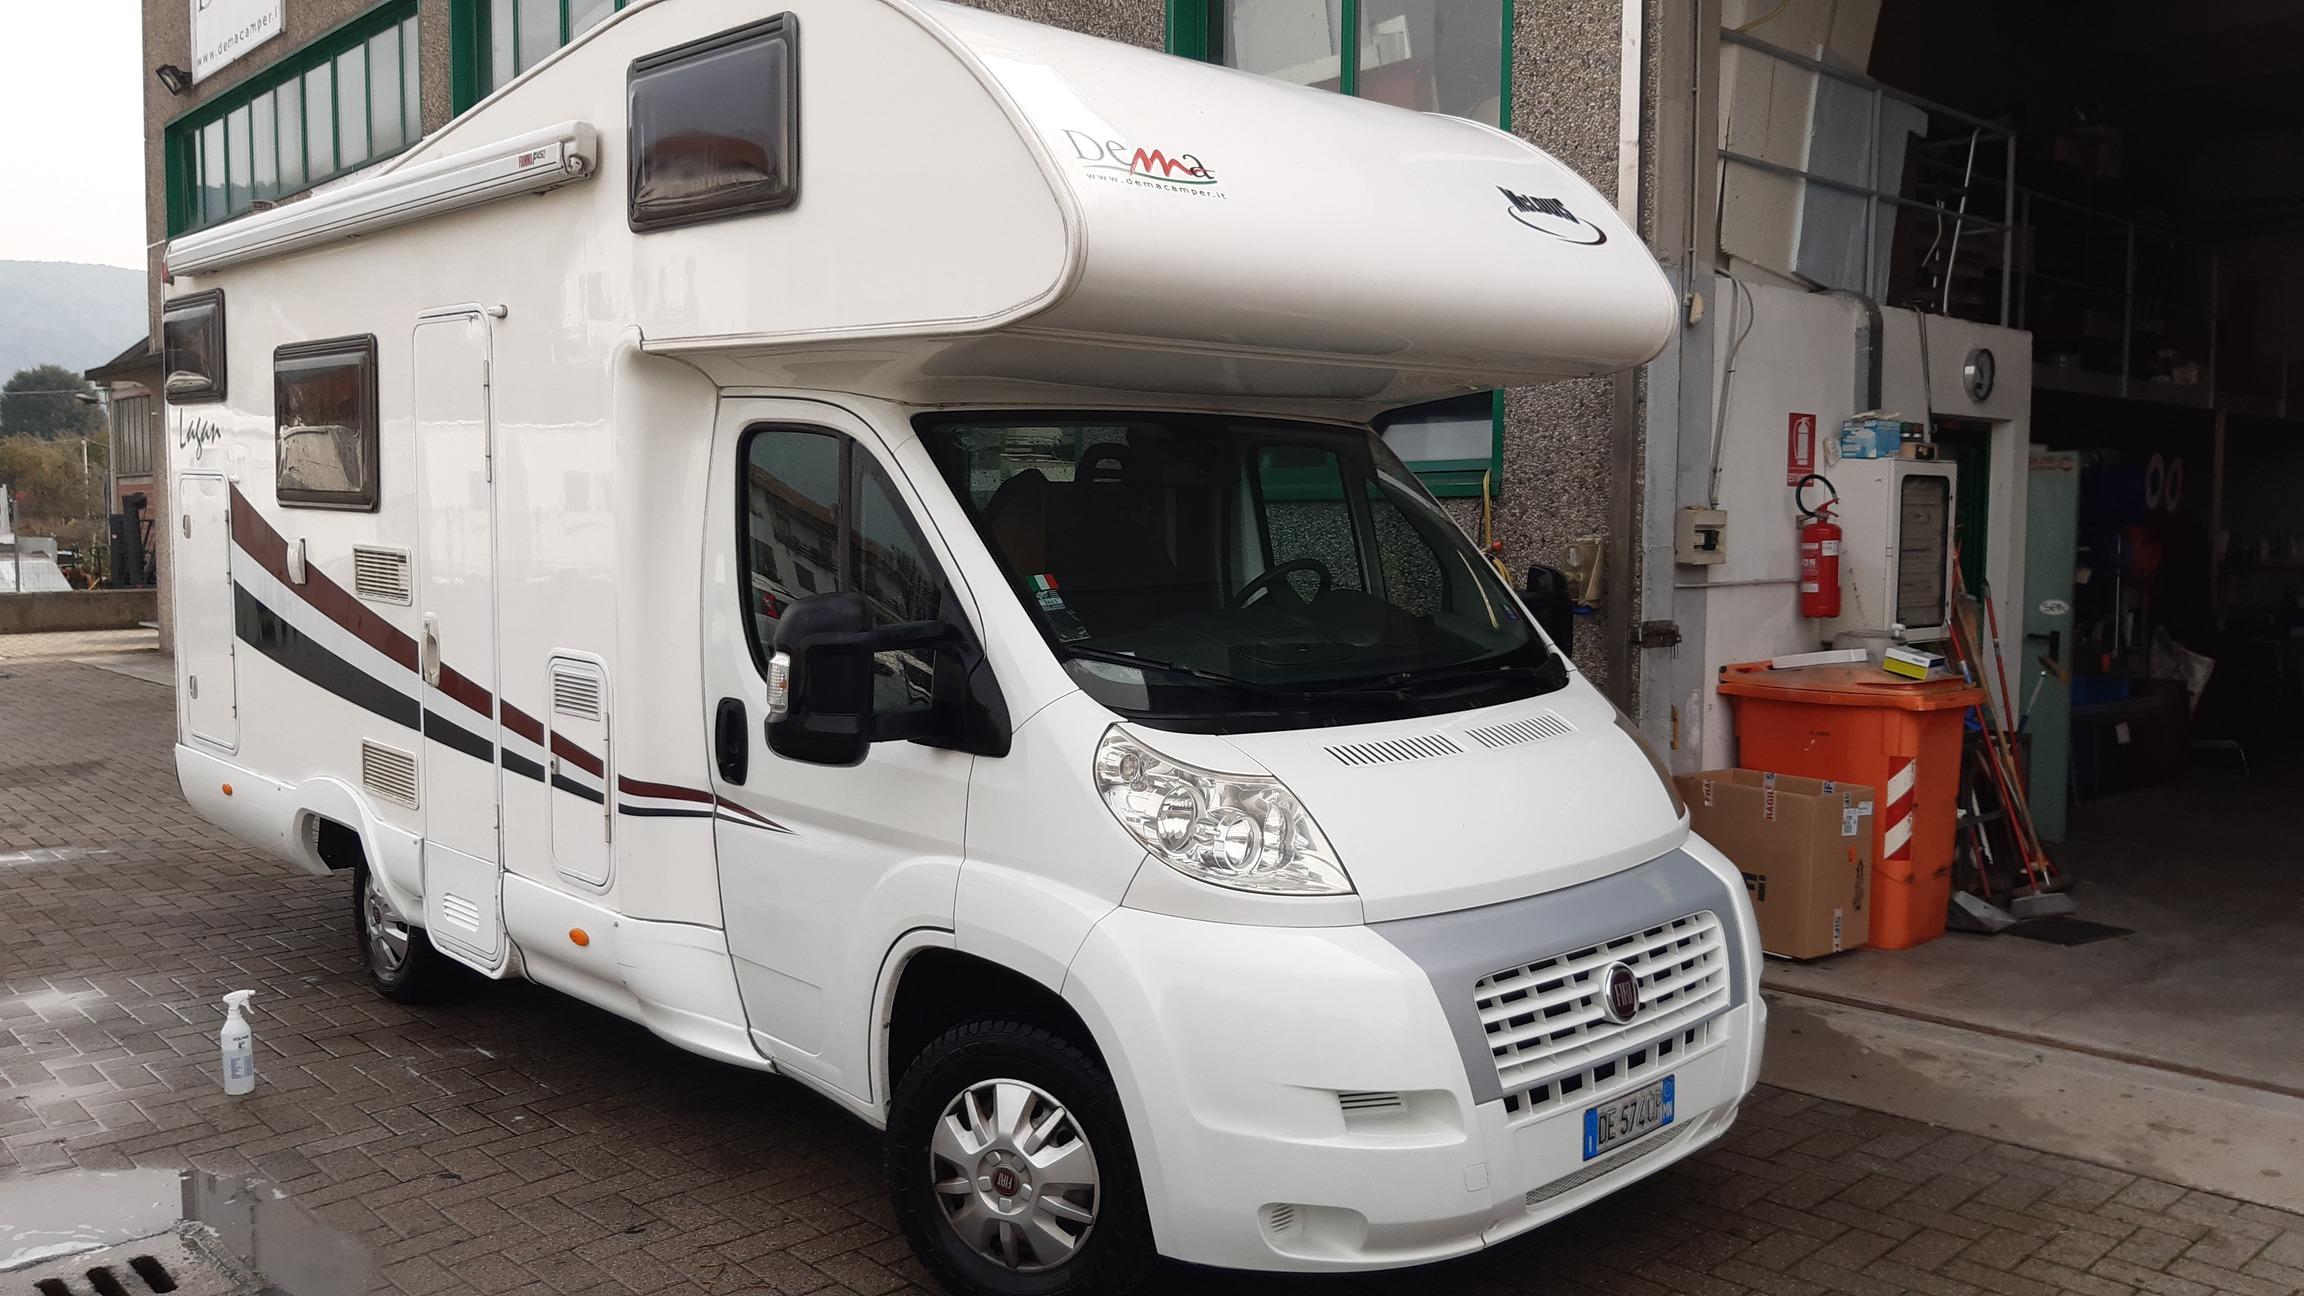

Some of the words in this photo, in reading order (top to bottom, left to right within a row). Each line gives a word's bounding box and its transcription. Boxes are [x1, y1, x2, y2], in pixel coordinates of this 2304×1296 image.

[1062, 129, 1216, 177] Dema
[1086, 172, 1228, 200] www.demacamper.it
[180, 408, 221, 460] Lagan
[1614, 981, 1633, 1007] FIAT
[1599, 1107, 1617, 1145] DE
[997, 1172, 1013, 1188] FIAT
